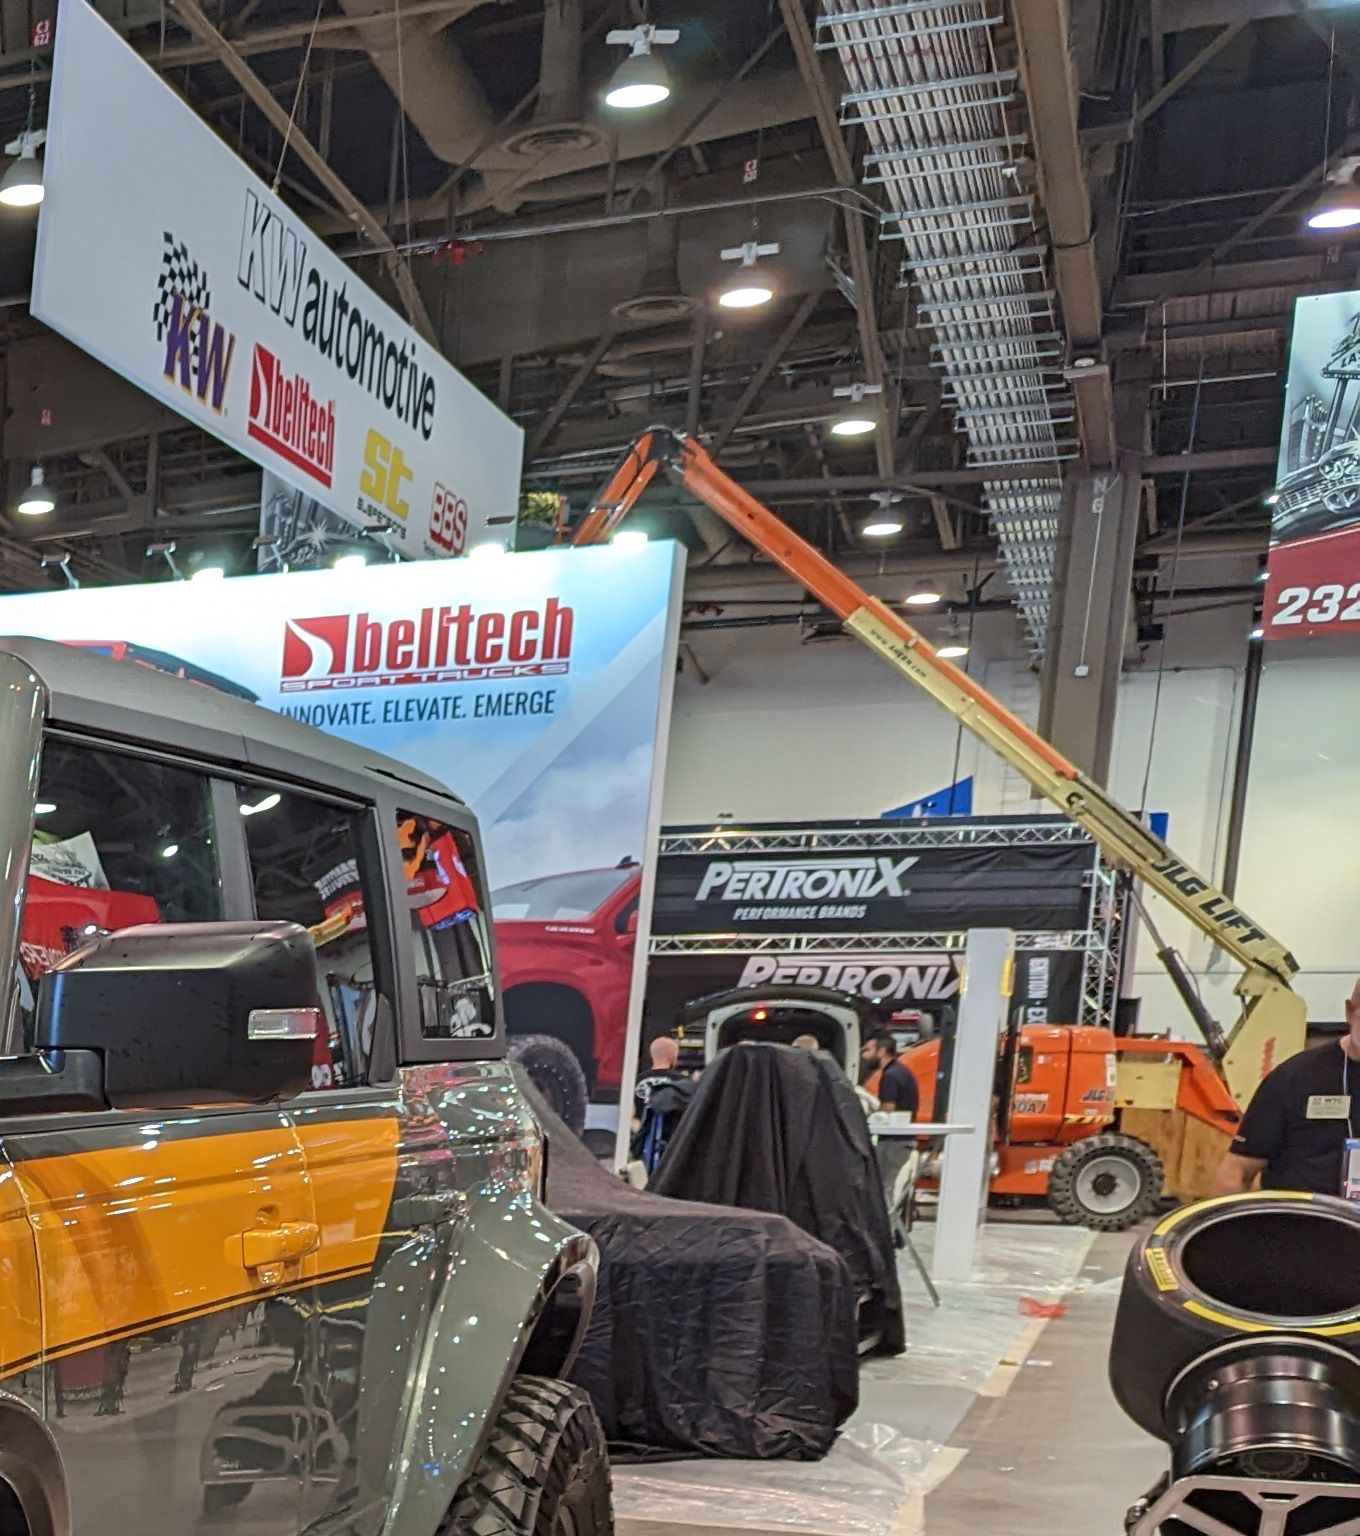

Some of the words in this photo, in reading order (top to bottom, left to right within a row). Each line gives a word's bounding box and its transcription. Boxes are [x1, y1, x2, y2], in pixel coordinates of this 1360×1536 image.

[302, 268, 435, 440] automotive
[429, 482, 468, 555] BBS
[353, 597, 574, 674] belltech
[281, 674, 398, 692] SPORT
[412, 661, 569, 684] TRUCKS
[383, 696, 466, 724] ELEVATE.
[473, 690, 557, 718] EMERGE
[733, 905, 817, 921] PERFORMANCE
[818, 904, 868, 919] BRANDS
[1151, 859, 1209, 898] JLG
[1199, 897, 1268, 946] LIFT
